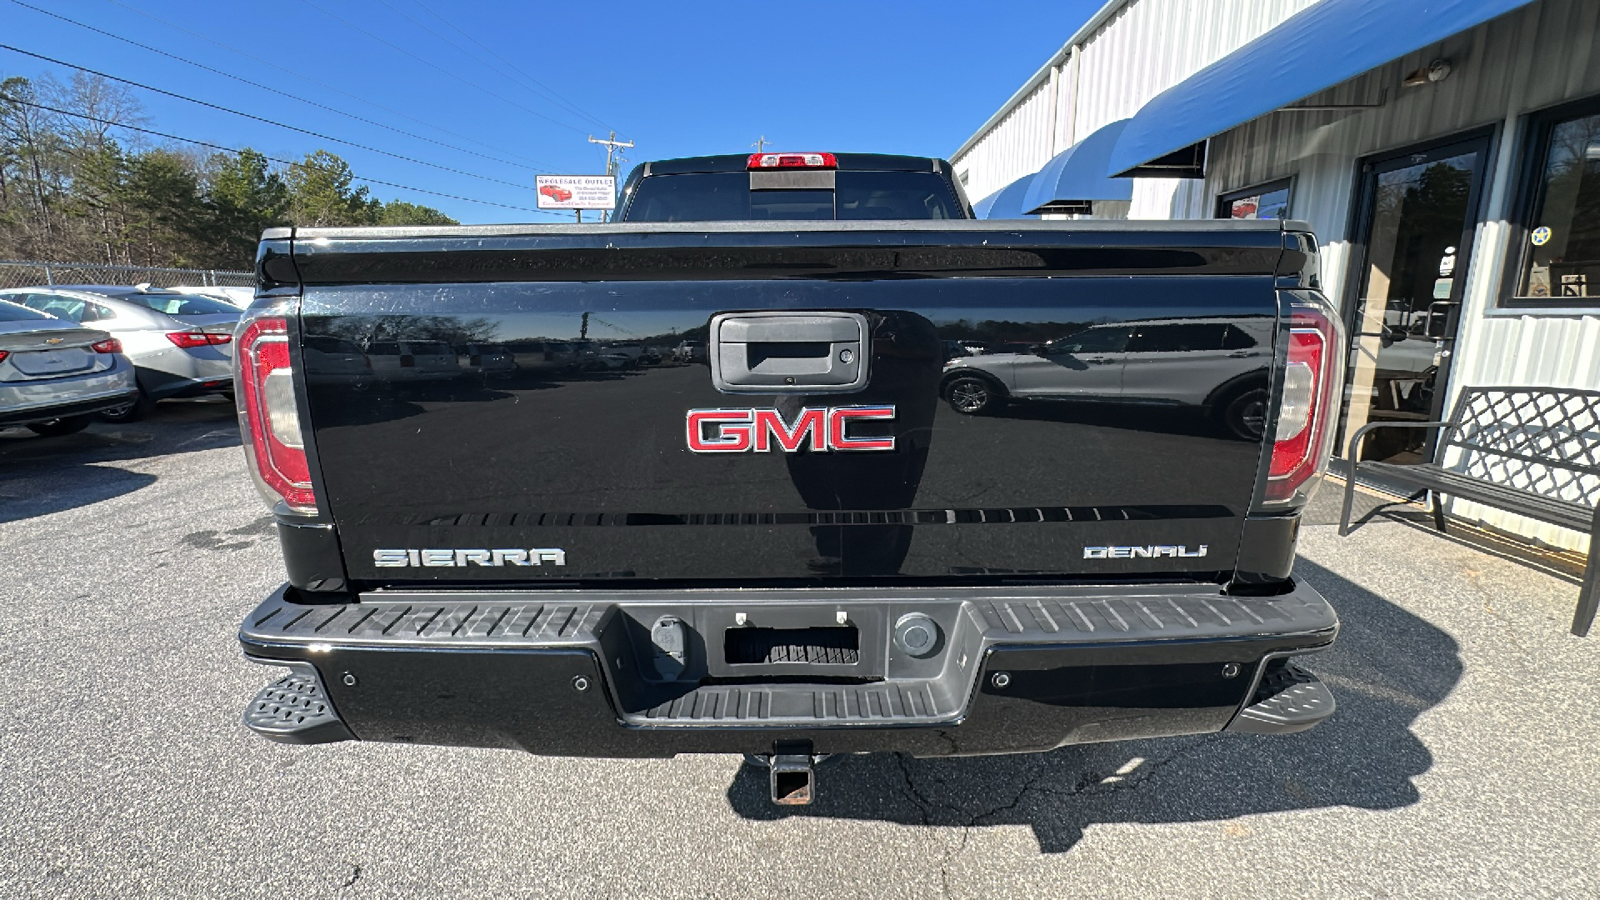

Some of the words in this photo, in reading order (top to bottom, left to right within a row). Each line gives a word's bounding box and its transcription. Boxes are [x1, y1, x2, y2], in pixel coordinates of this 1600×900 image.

[686, 404, 896, 453] GMC
[373, 548, 566, 568] SIERRA
[1083, 545, 1208, 559] DENALI
